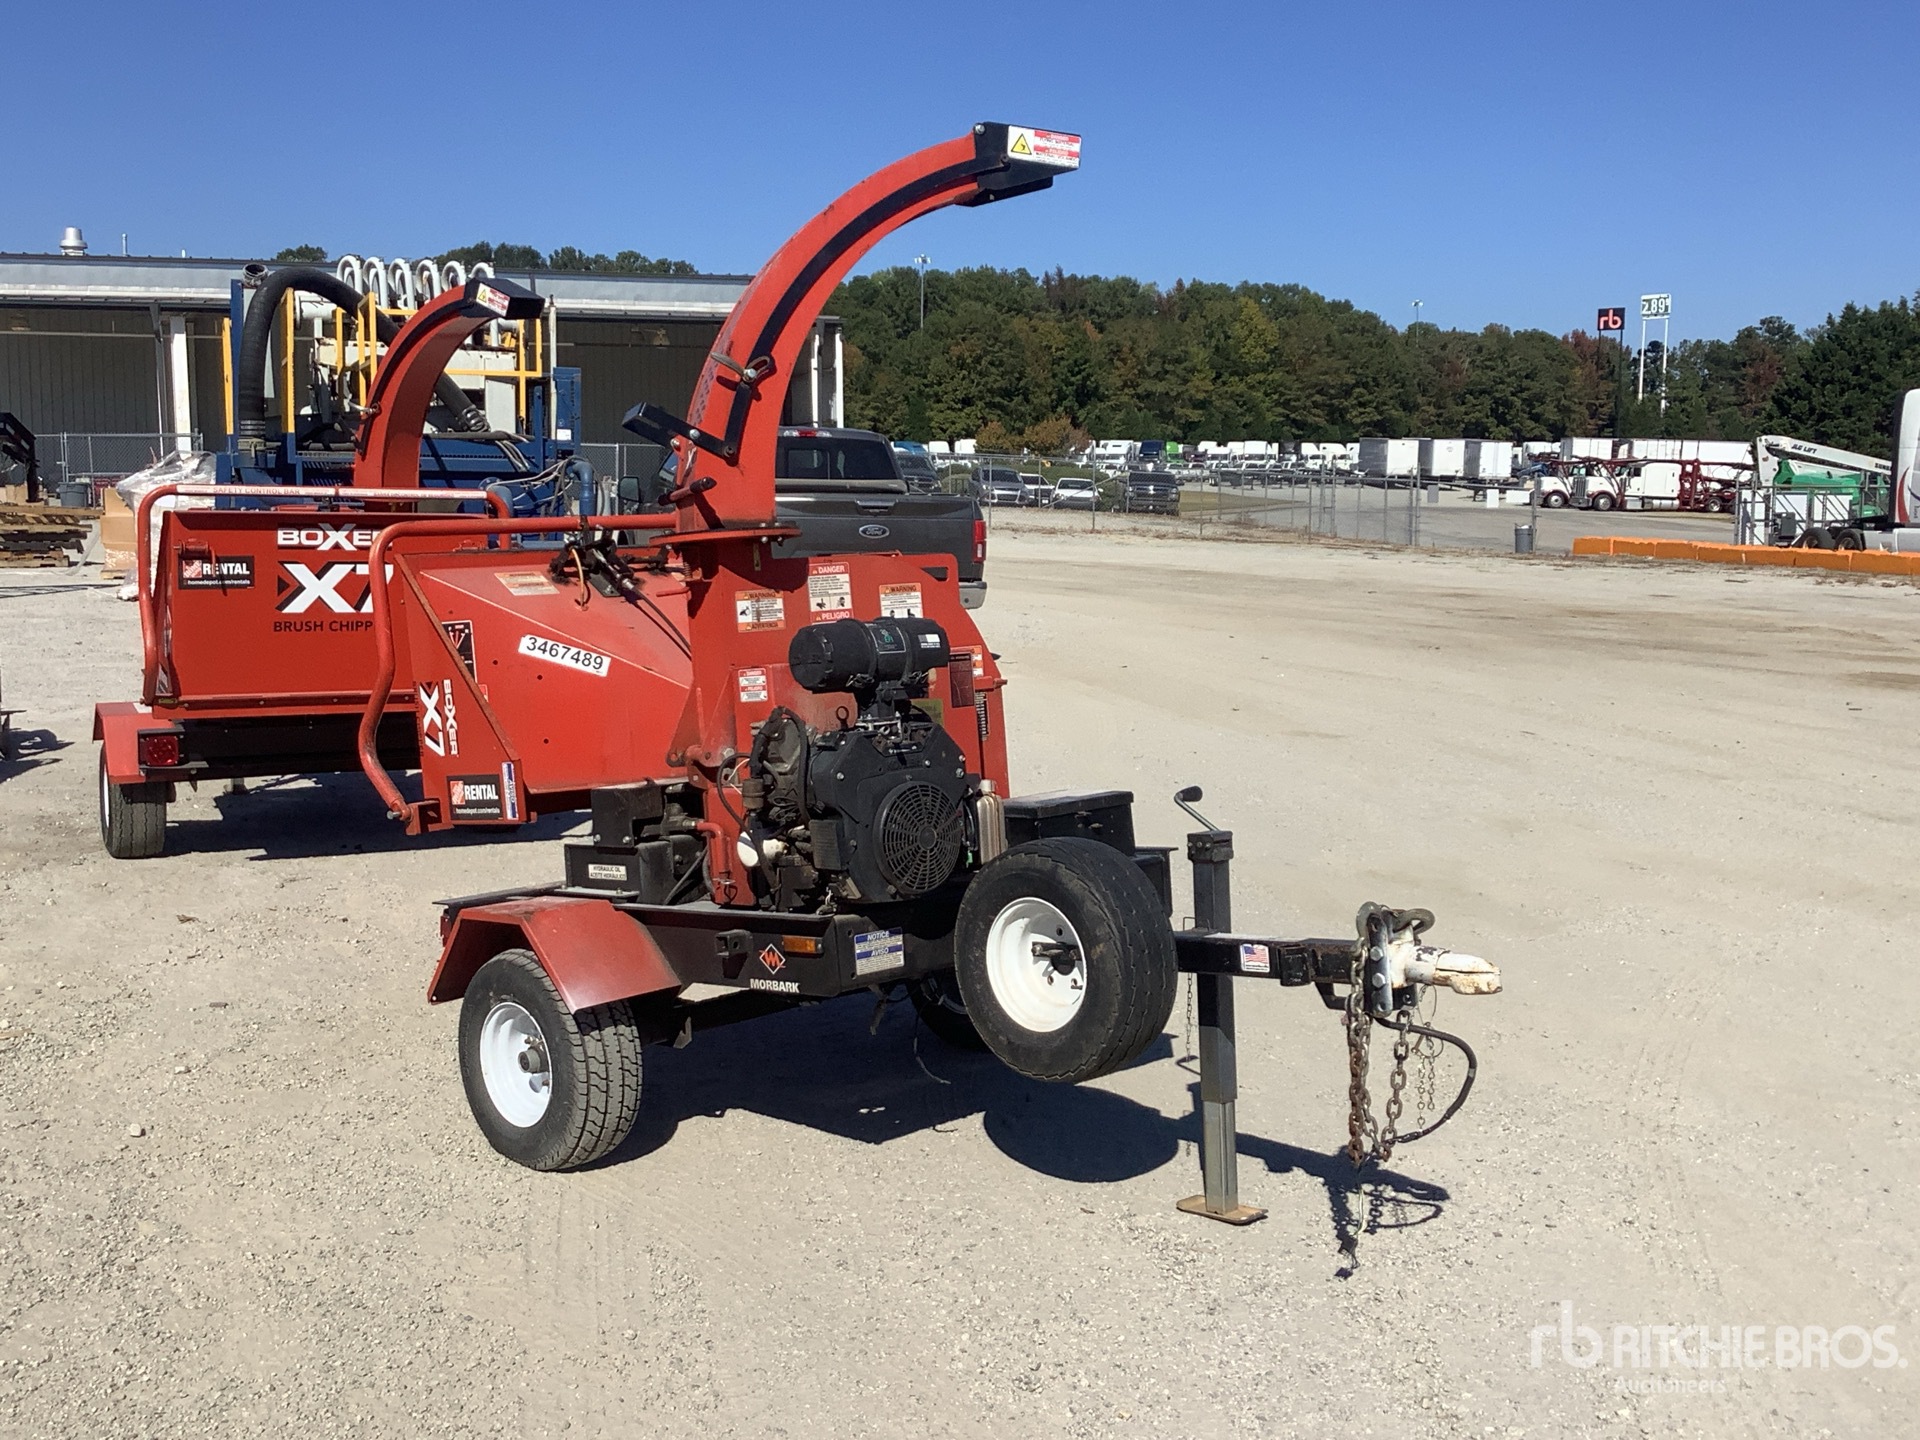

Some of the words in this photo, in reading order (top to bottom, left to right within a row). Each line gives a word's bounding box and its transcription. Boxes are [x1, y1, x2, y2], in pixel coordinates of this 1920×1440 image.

[1599, 308, 1622, 330] rb
[213, 486, 242, 494] SAFETY
[244, 487, 283, 495] CONTROL
[283, 488, 300, 496] BAR
[202, 562, 251, 575] RENTAL
[818, 565, 846, 574] DANGER
[890, 584, 917, 593] WARNING
[821, 611, 851, 621] PELIGRO
[273, 620, 324, 632] BRUSH
[526, 636, 604, 670] 3467489
[419, 684, 446, 757] X7
[443, 679, 459, 756] BOXER
[464, 784, 499, 801] RENTAL
[867, 931, 890, 941] NOTICE
[871, 947, 889, 957] AVISO
[750, 978, 800, 993] MORBARK
